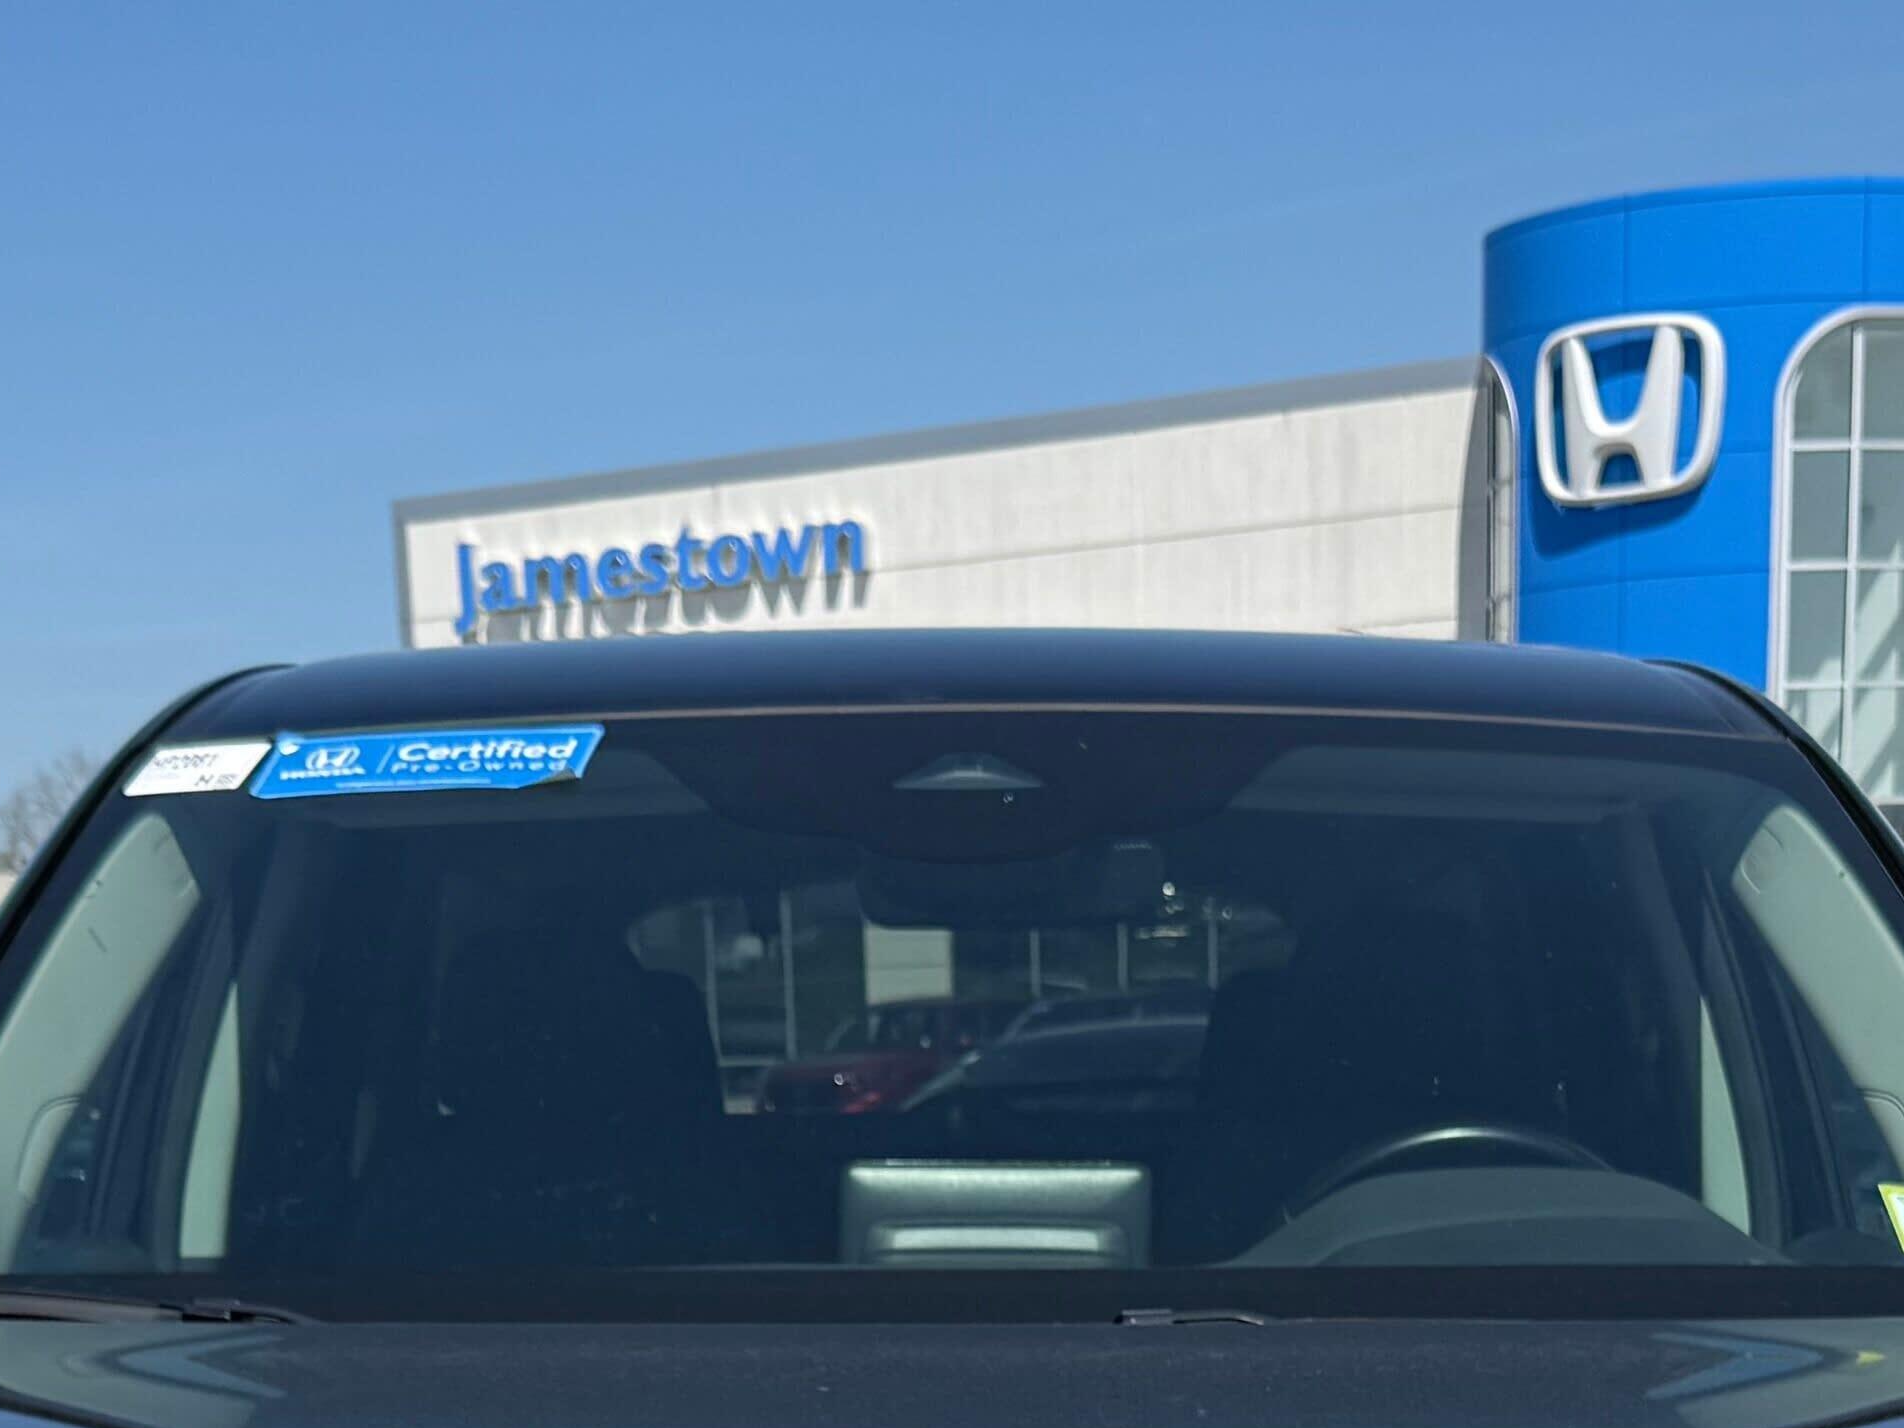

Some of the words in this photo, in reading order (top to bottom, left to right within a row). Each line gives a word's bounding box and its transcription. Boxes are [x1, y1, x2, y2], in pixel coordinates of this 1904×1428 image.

[454, 518, 865, 636] Jamestown
[398, 737, 577, 763] Certified
[390, 760, 567, 775] Pre-Owned
